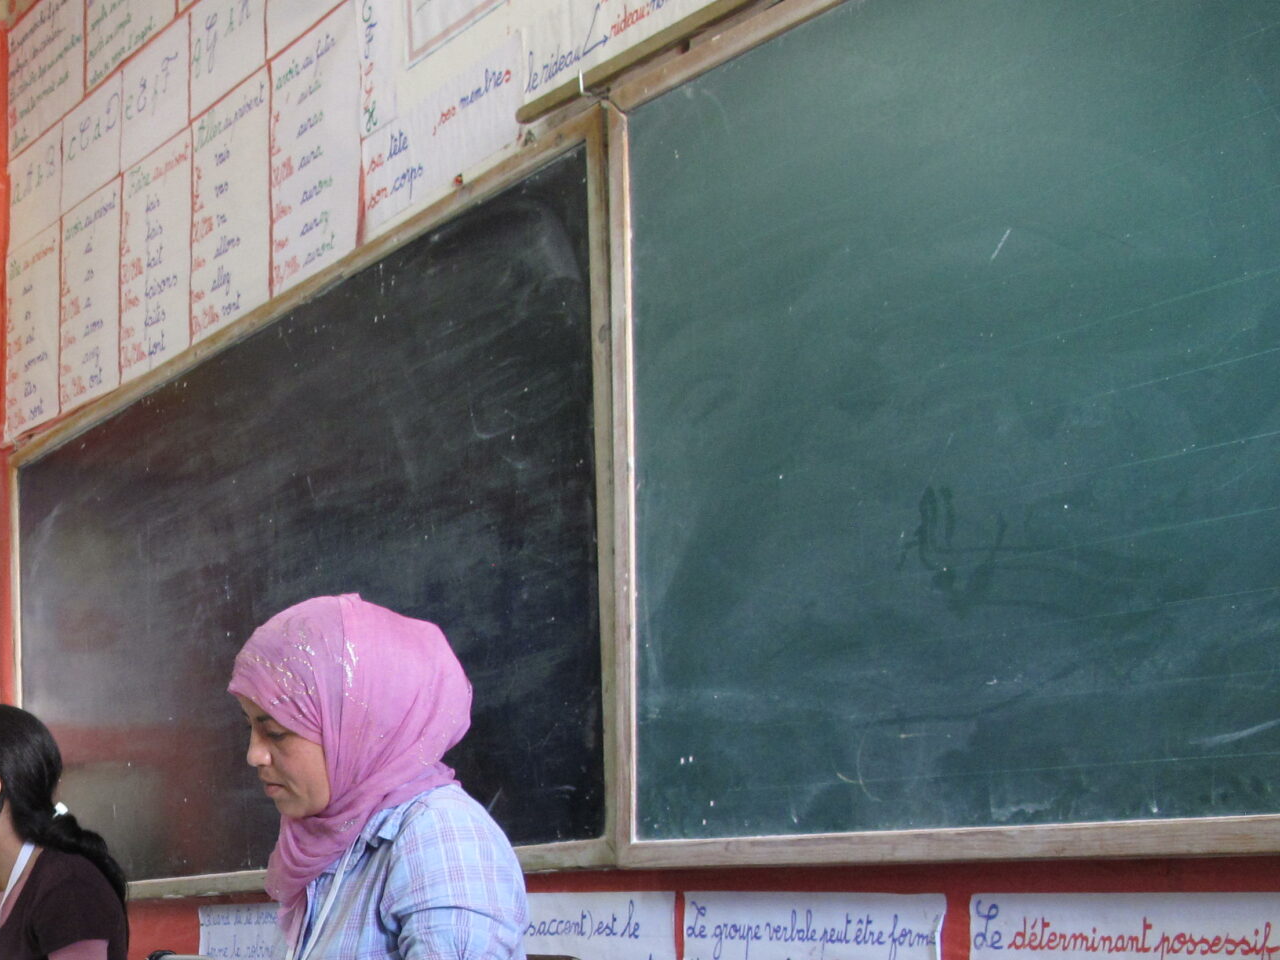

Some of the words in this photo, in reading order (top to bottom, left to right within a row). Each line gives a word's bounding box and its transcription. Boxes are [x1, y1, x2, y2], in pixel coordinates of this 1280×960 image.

[524, 50, 539, 94] le
[539, 43, 581, 85] rideau
[390, 162, 423, 201] corps
[593, 914, 617, 936] est
[621, 899, 640, 939] le
[686, 900, 707, 938] Le
[765, 909, 817, 942] verbale
[818, 912, 852, 960] peut
[853, 918, 885, 947] être
[973, 899, 1004, 950] Le
[1008, 916, 1151, 954] déterminant
